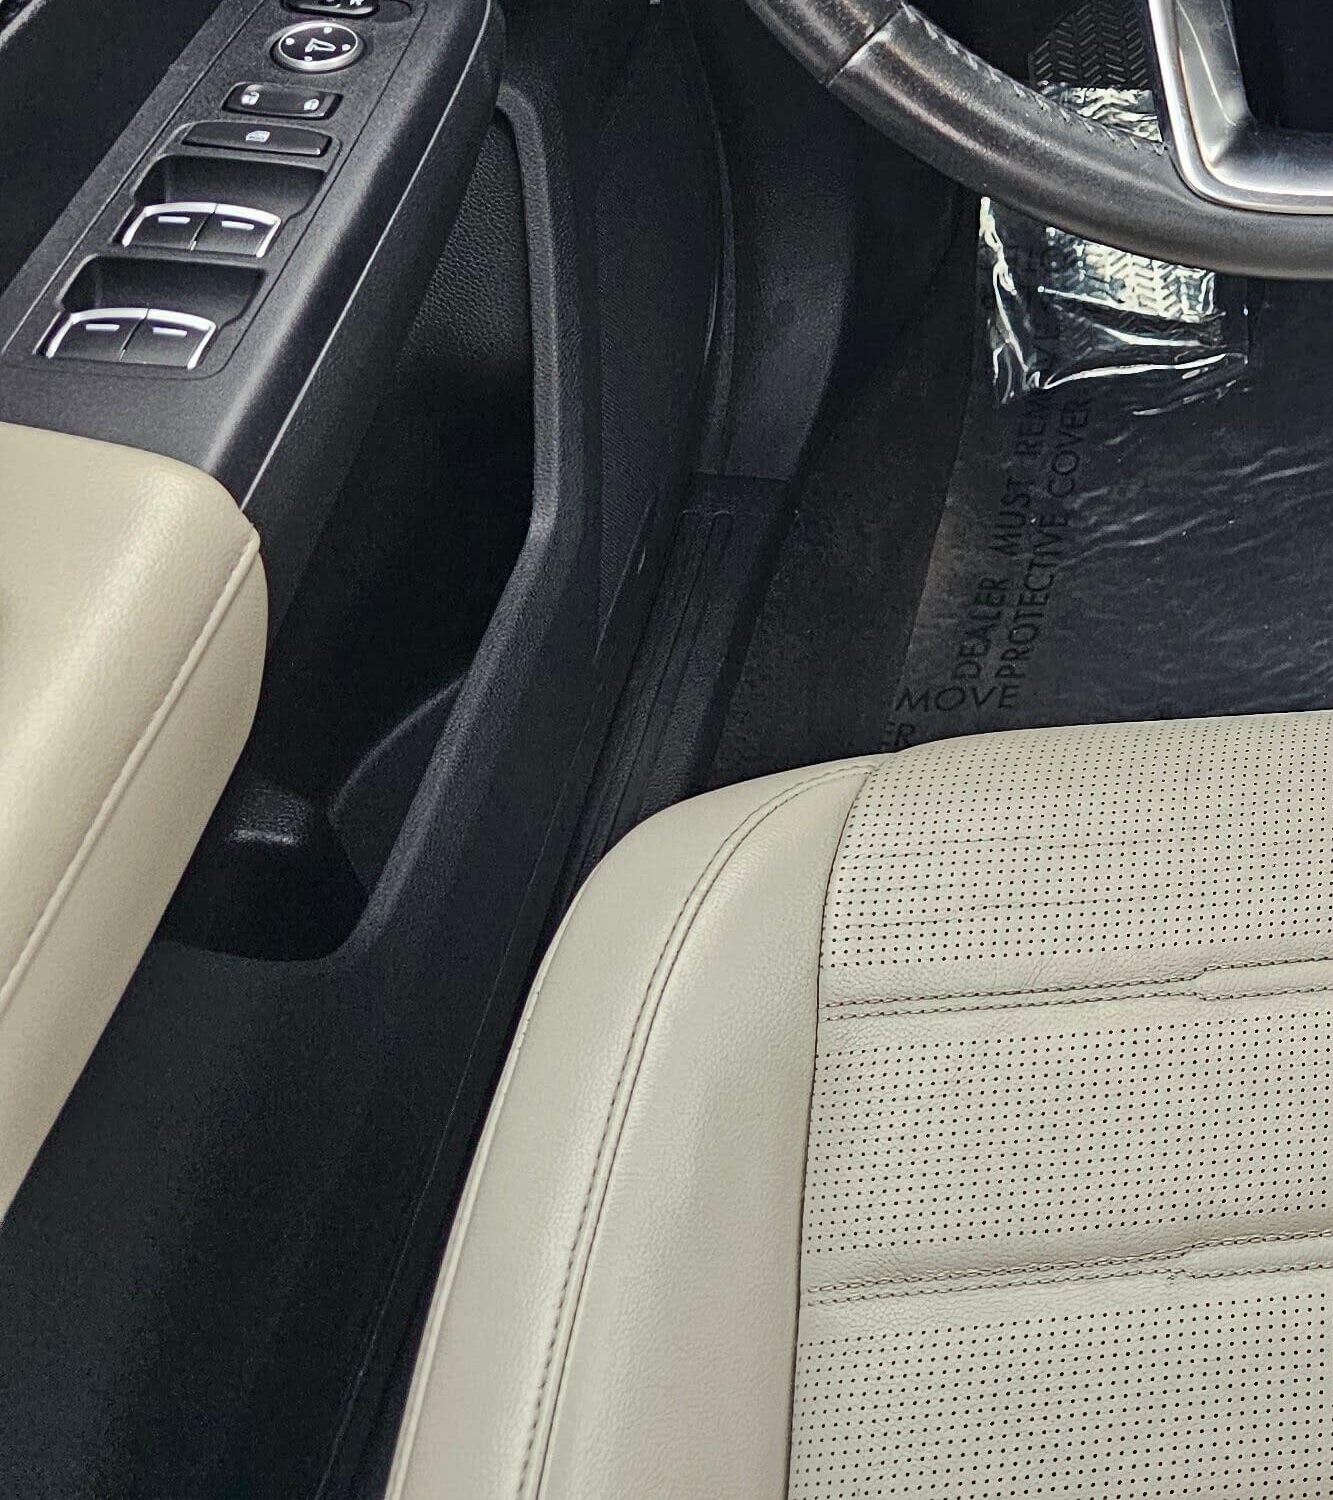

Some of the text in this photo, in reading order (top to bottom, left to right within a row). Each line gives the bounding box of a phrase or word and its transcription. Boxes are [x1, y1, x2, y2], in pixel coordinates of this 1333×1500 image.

[992, 477, 1032, 557] MUST
[995, 513, 1060, 679] PROTECTIVE
[895, 684, 1022, 712] MOVE
